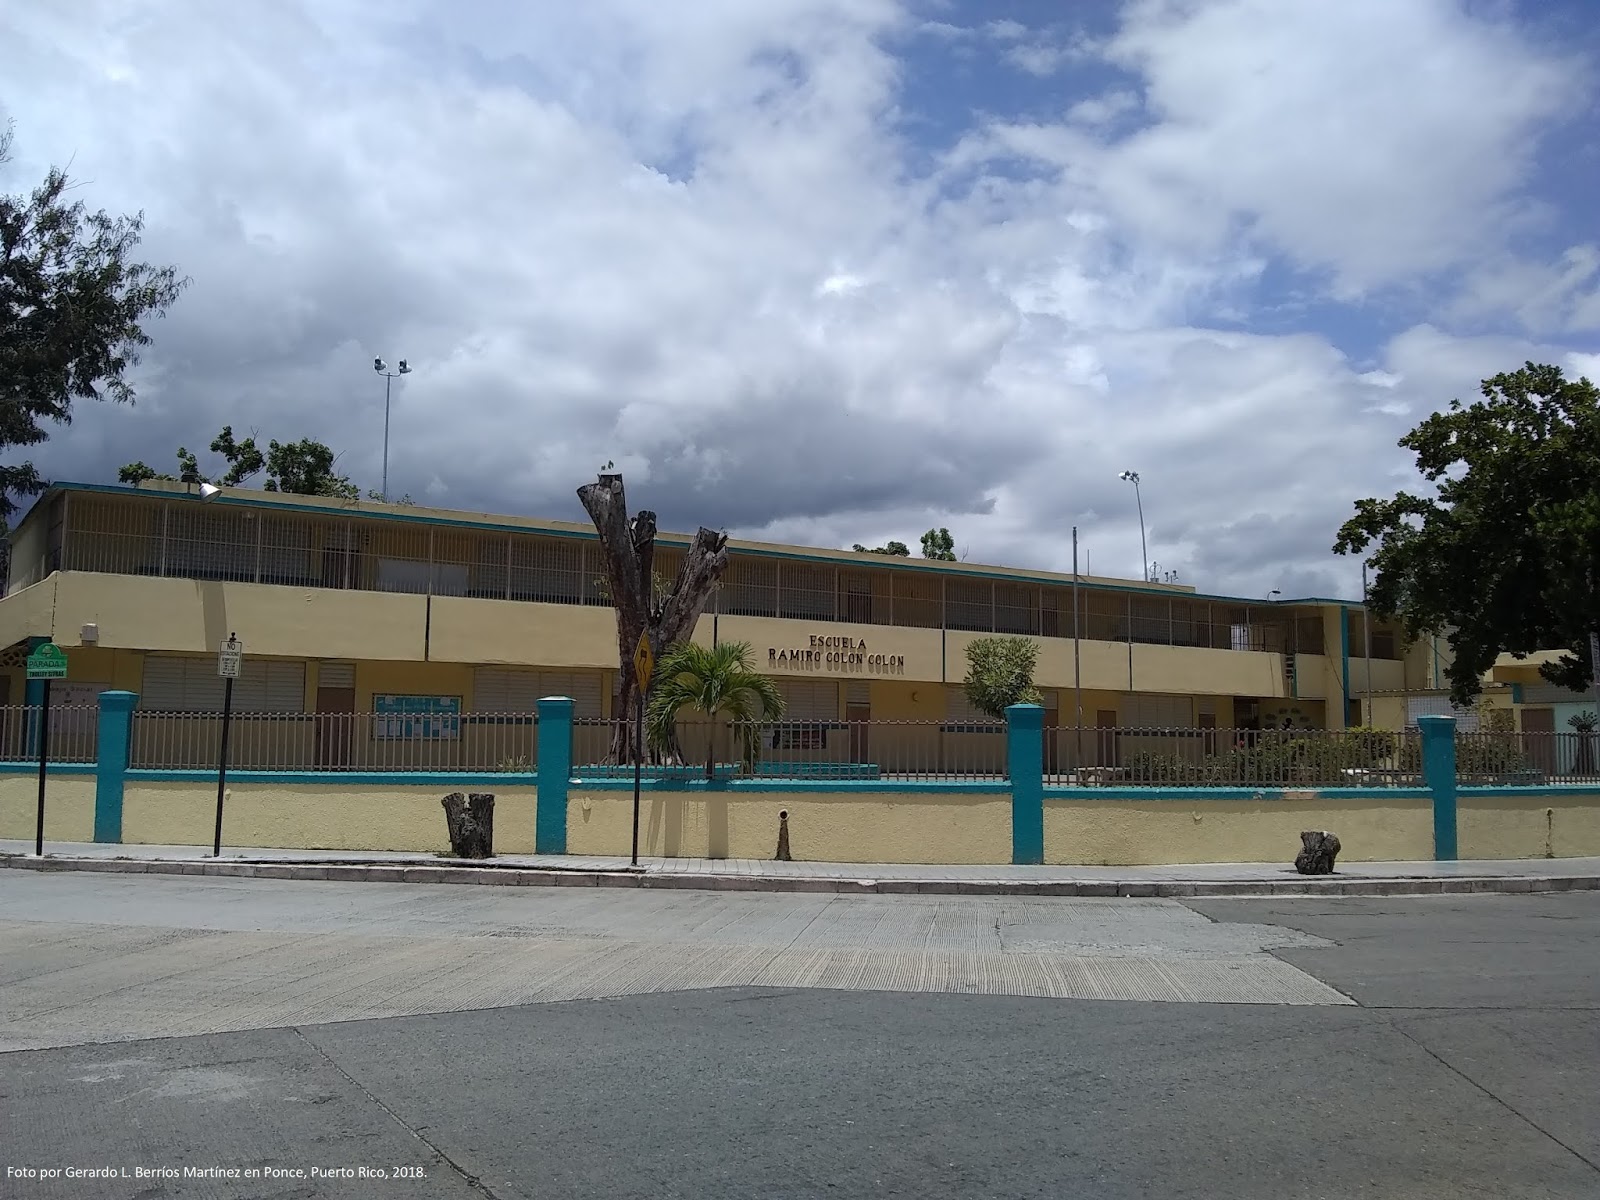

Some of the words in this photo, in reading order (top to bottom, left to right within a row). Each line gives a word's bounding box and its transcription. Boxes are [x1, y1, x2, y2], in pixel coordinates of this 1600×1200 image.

[226, 643, 236, 651] NO
[809, 635, 867, 650] ESCUELA
[768, 648, 821, 663] RAMIRO
[826, 651, 863, 665] COLON
[868, 654, 904, 667] COLON
[28, 660, 60, 669] PARADA
